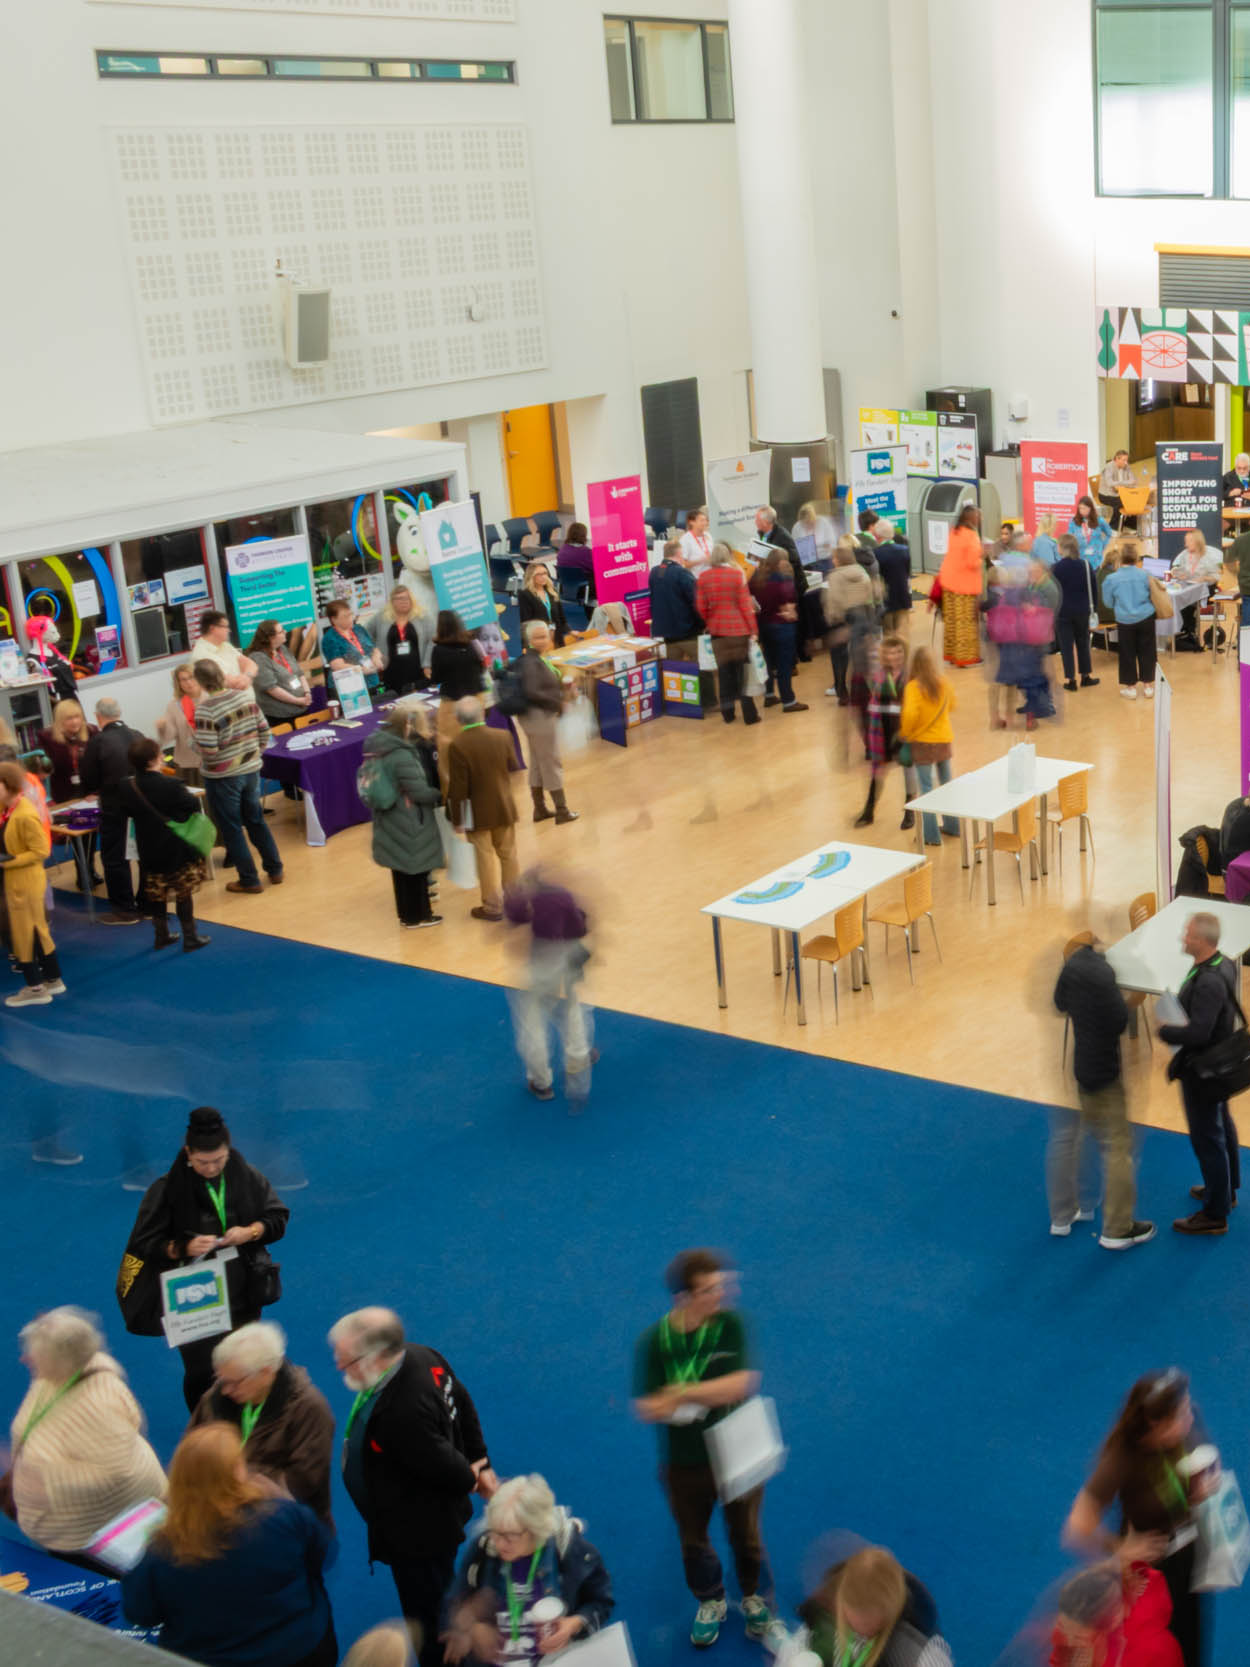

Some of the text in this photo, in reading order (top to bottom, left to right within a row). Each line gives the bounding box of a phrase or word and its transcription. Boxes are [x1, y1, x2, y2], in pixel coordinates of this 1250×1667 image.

[1161, 451, 1189, 462] CARE
[1161, 479, 1218, 489] IMPROVING
[1161, 487, 1193, 496] SHORT
[1161, 495, 1218, 504] BREAKS FOR
[1161, 504, 1218, 512] SCOTLAND'S
[1161, 512, 1199, 520] UNPAID
[1161, 520, 1198, 529] CARERS
[615, 539, 638, 552] starts
[614, 551, 634, 564] with
[602, 561, 647, 579] community
